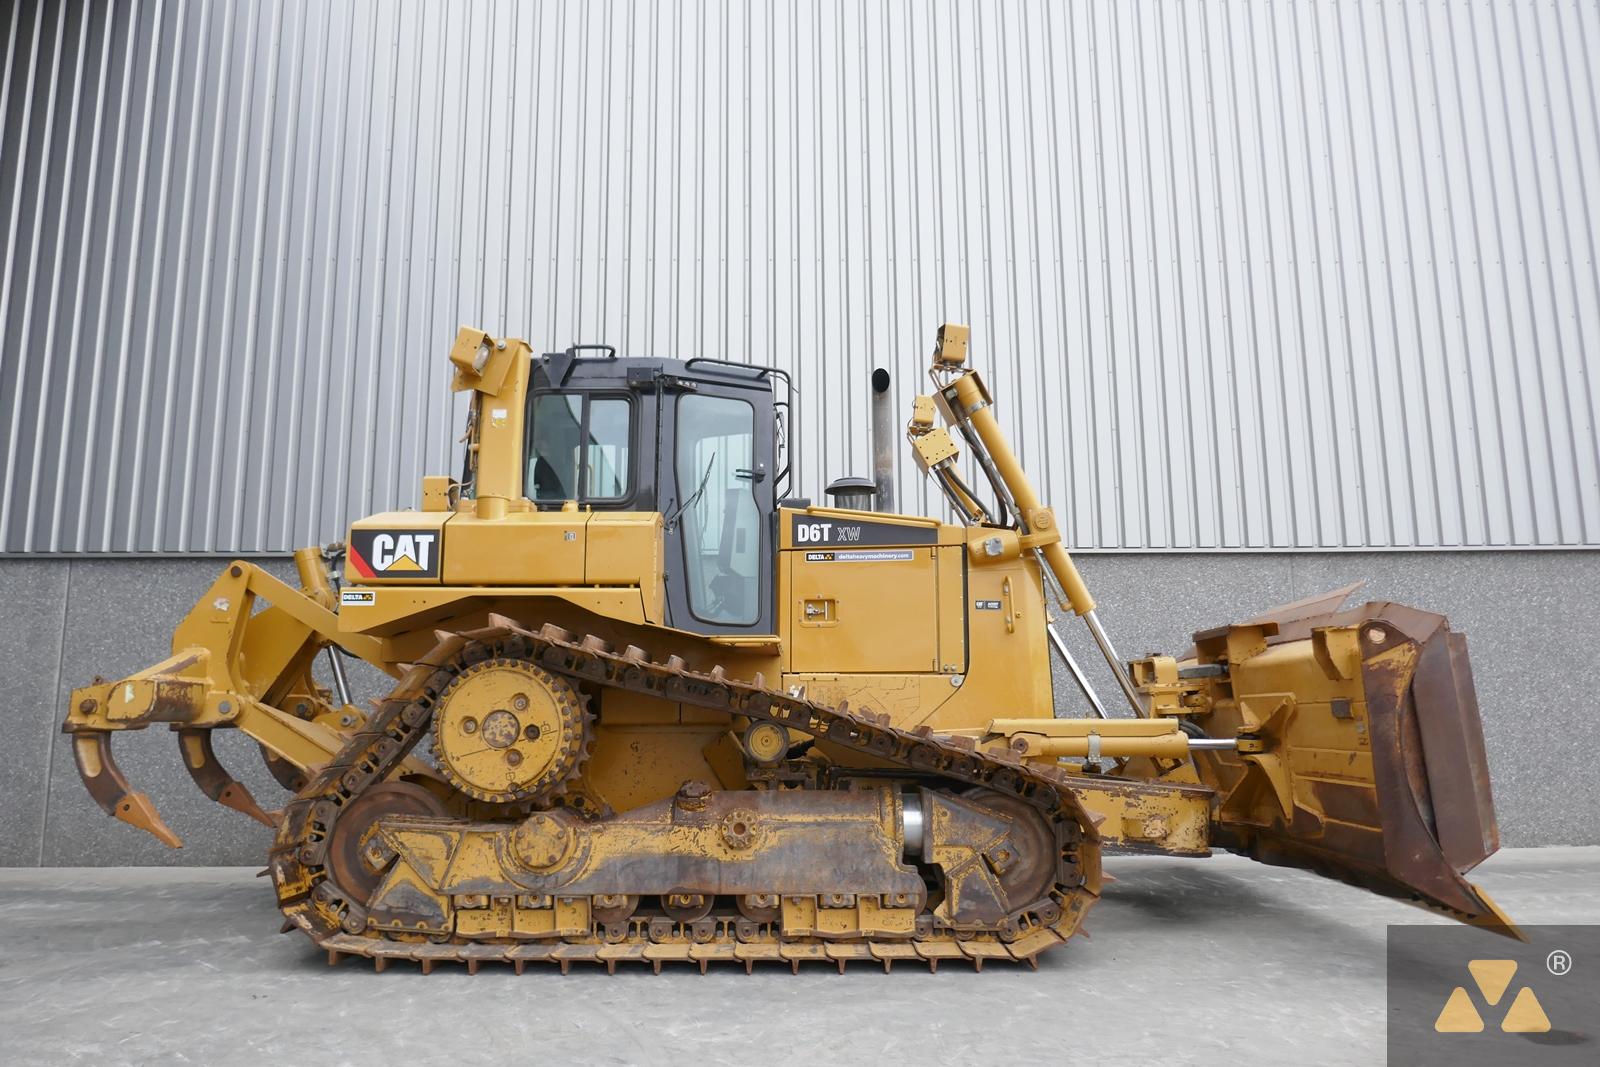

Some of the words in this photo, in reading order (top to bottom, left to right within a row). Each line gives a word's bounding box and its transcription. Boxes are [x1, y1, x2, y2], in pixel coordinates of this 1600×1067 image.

[797, 523, 832, 542] D6T
[837, 526, 860, 541] XW
[371, 533, 435, 571] CAT
